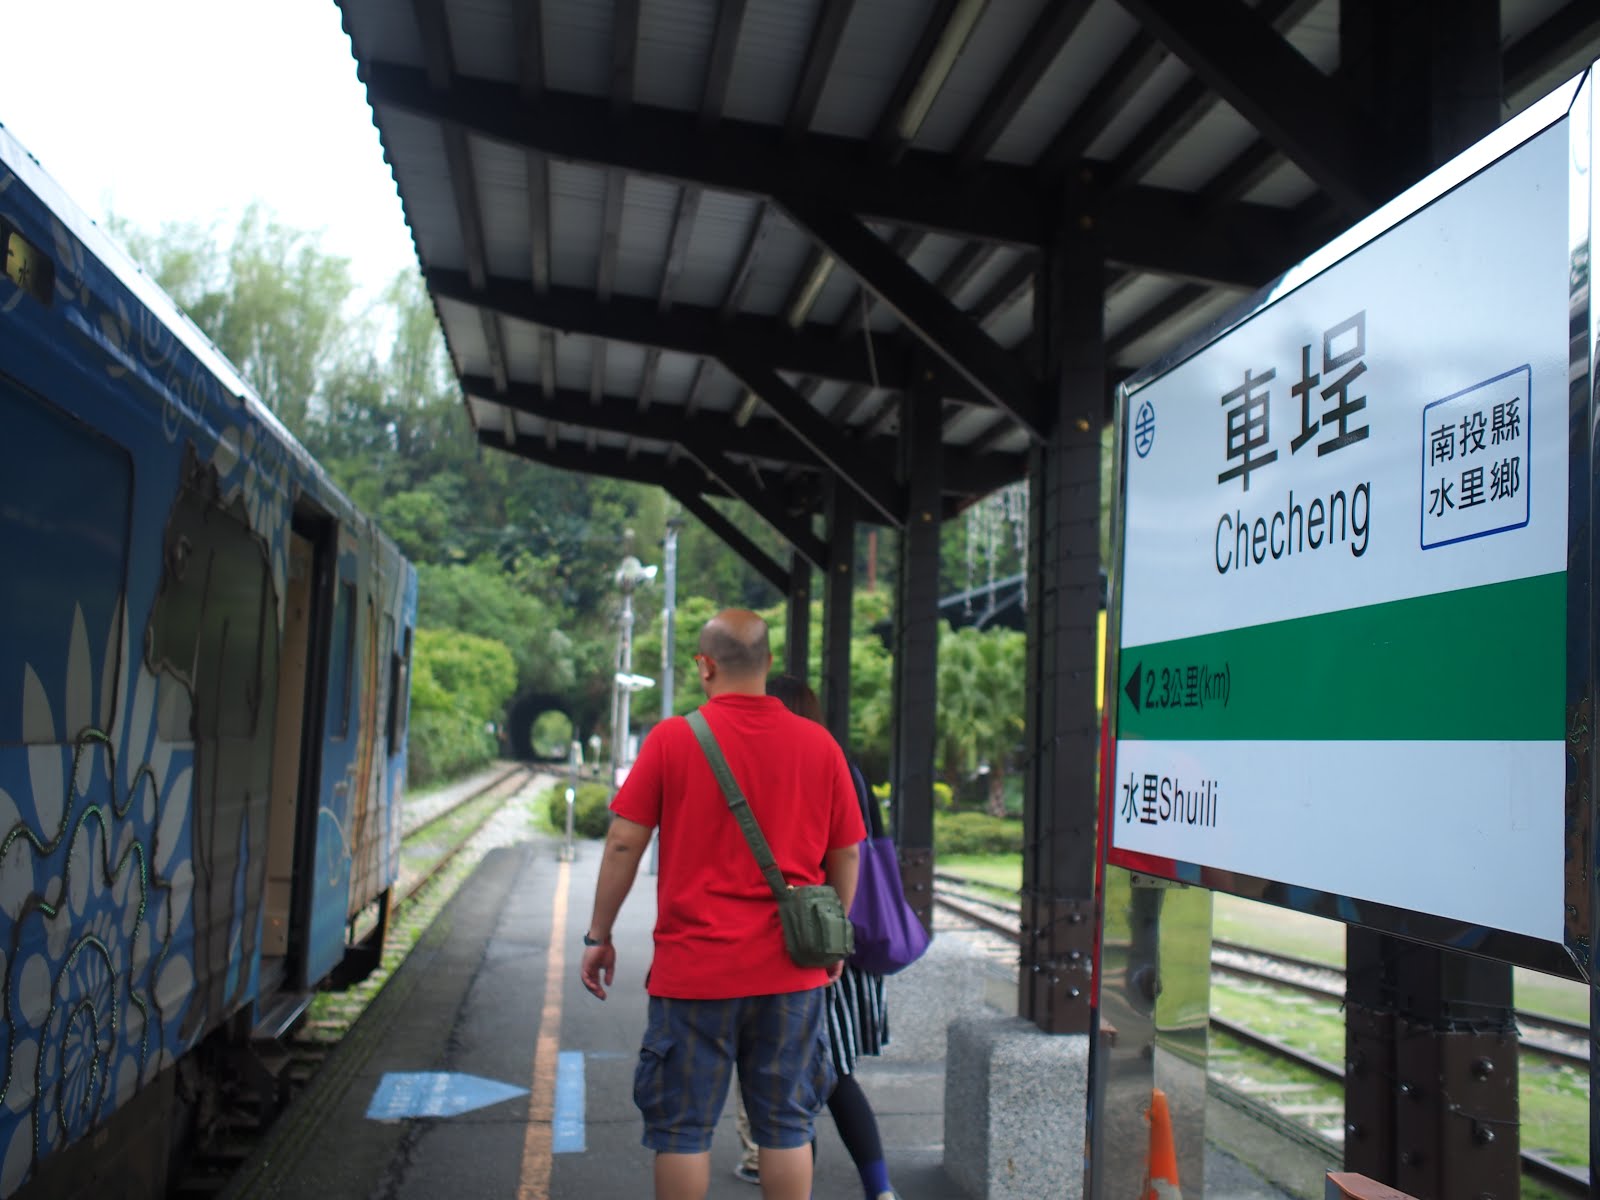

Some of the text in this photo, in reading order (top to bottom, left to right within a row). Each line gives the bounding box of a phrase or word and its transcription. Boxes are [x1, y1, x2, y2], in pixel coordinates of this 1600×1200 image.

[1218, 309, 1369, 492] 車埕
[1430, 397, 1521, 467] 南投縣
[1428, 456, 1521, 517] 水里鄉
[1215, 482, 1371, 575] Checheng
